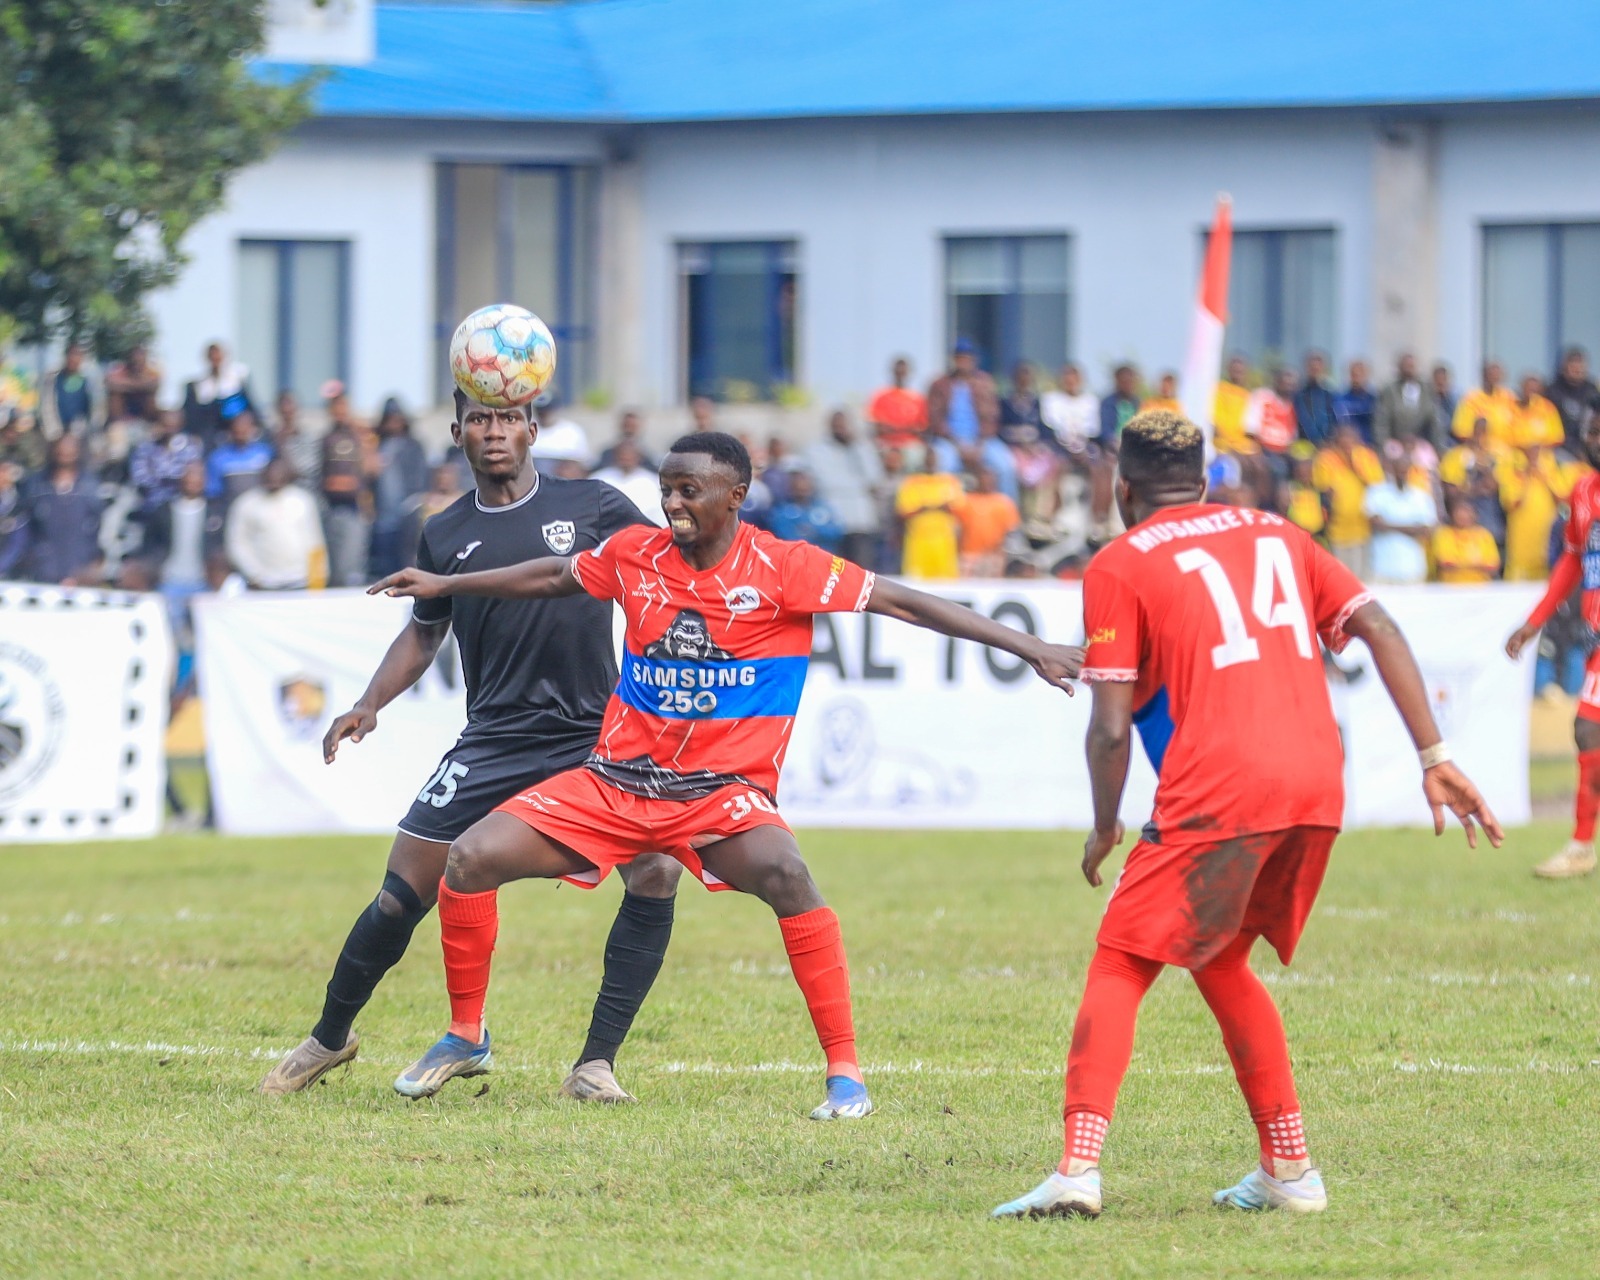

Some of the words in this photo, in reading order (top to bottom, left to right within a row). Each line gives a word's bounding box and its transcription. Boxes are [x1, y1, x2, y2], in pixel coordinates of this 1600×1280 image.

[1127, 509, 1242, 554] MUSANZE
[820, 555, 844, 605] easyHA
[1173, 536, 1314, 671] 14
[809, 611, 897, 680] AL
[632, 662, 756, 688] SAMSUNG
[658, 690, 717, 713] 250
[416, 758, 470, 809] 25
